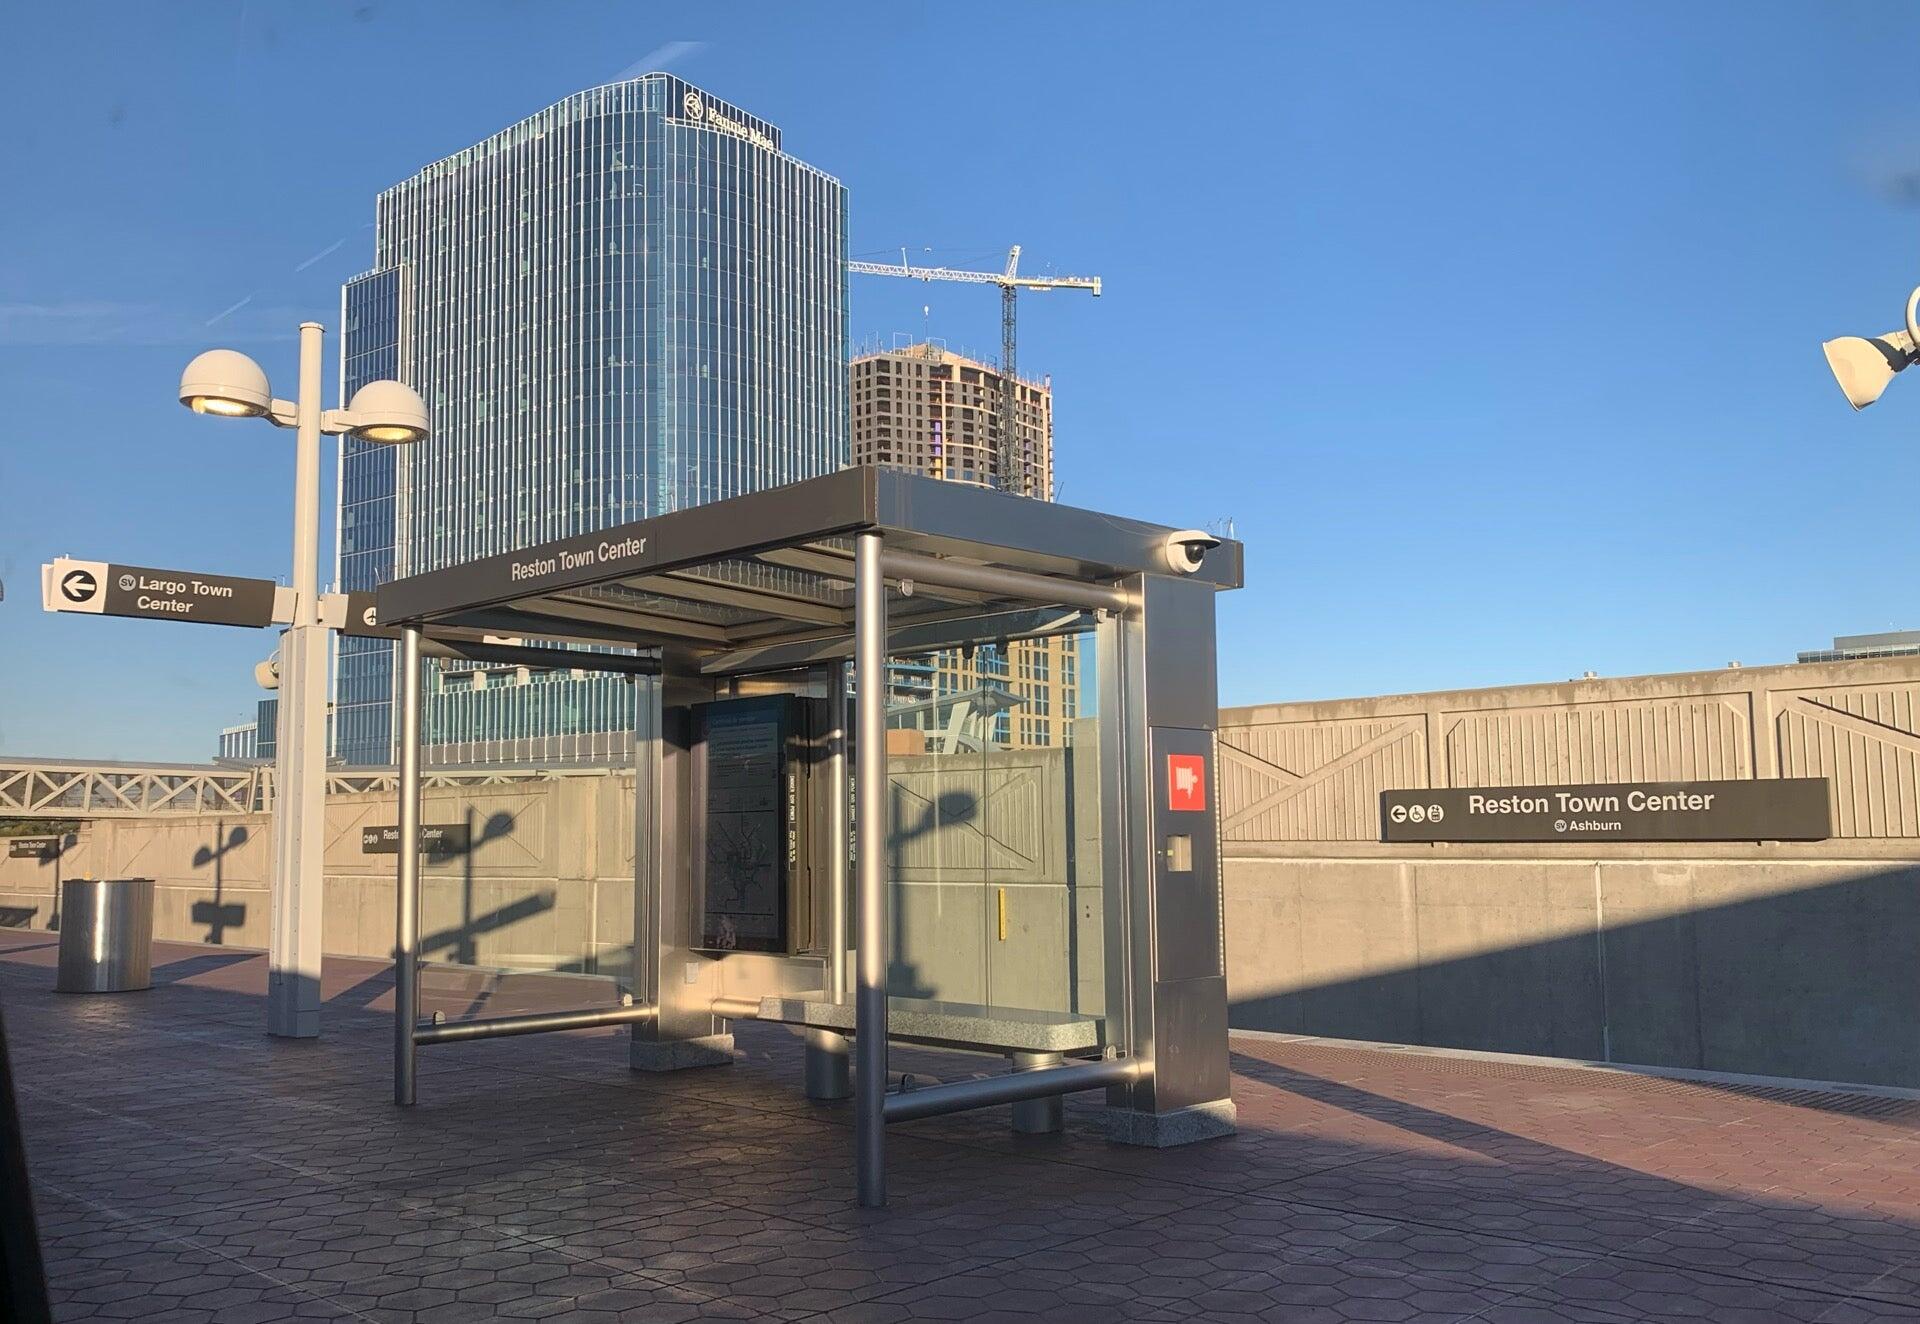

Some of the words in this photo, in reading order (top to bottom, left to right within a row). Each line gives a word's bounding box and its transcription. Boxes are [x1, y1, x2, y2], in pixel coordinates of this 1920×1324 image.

[750, 127, 774, 151] Mae
[511, 558, 556, 581] Reston
[559, 549, 594, 571] Town
[598, 537, 647, 562] Center
[120, 578, 135, 588] SV
[138, 576, 187, 595] Largo
[191, 581, 233, 598] Town
[137, 596, 194, 613] Center
[1469, 795, 1549, 814] Reston
[1555, 793, 1620, 813] Town
[1627, 790, 1715, 812] Center
[383, 829, 400, 840] Rest
[421, 828, 443, 839] Center
[1569, 820, 1622, 831] Ashburn
